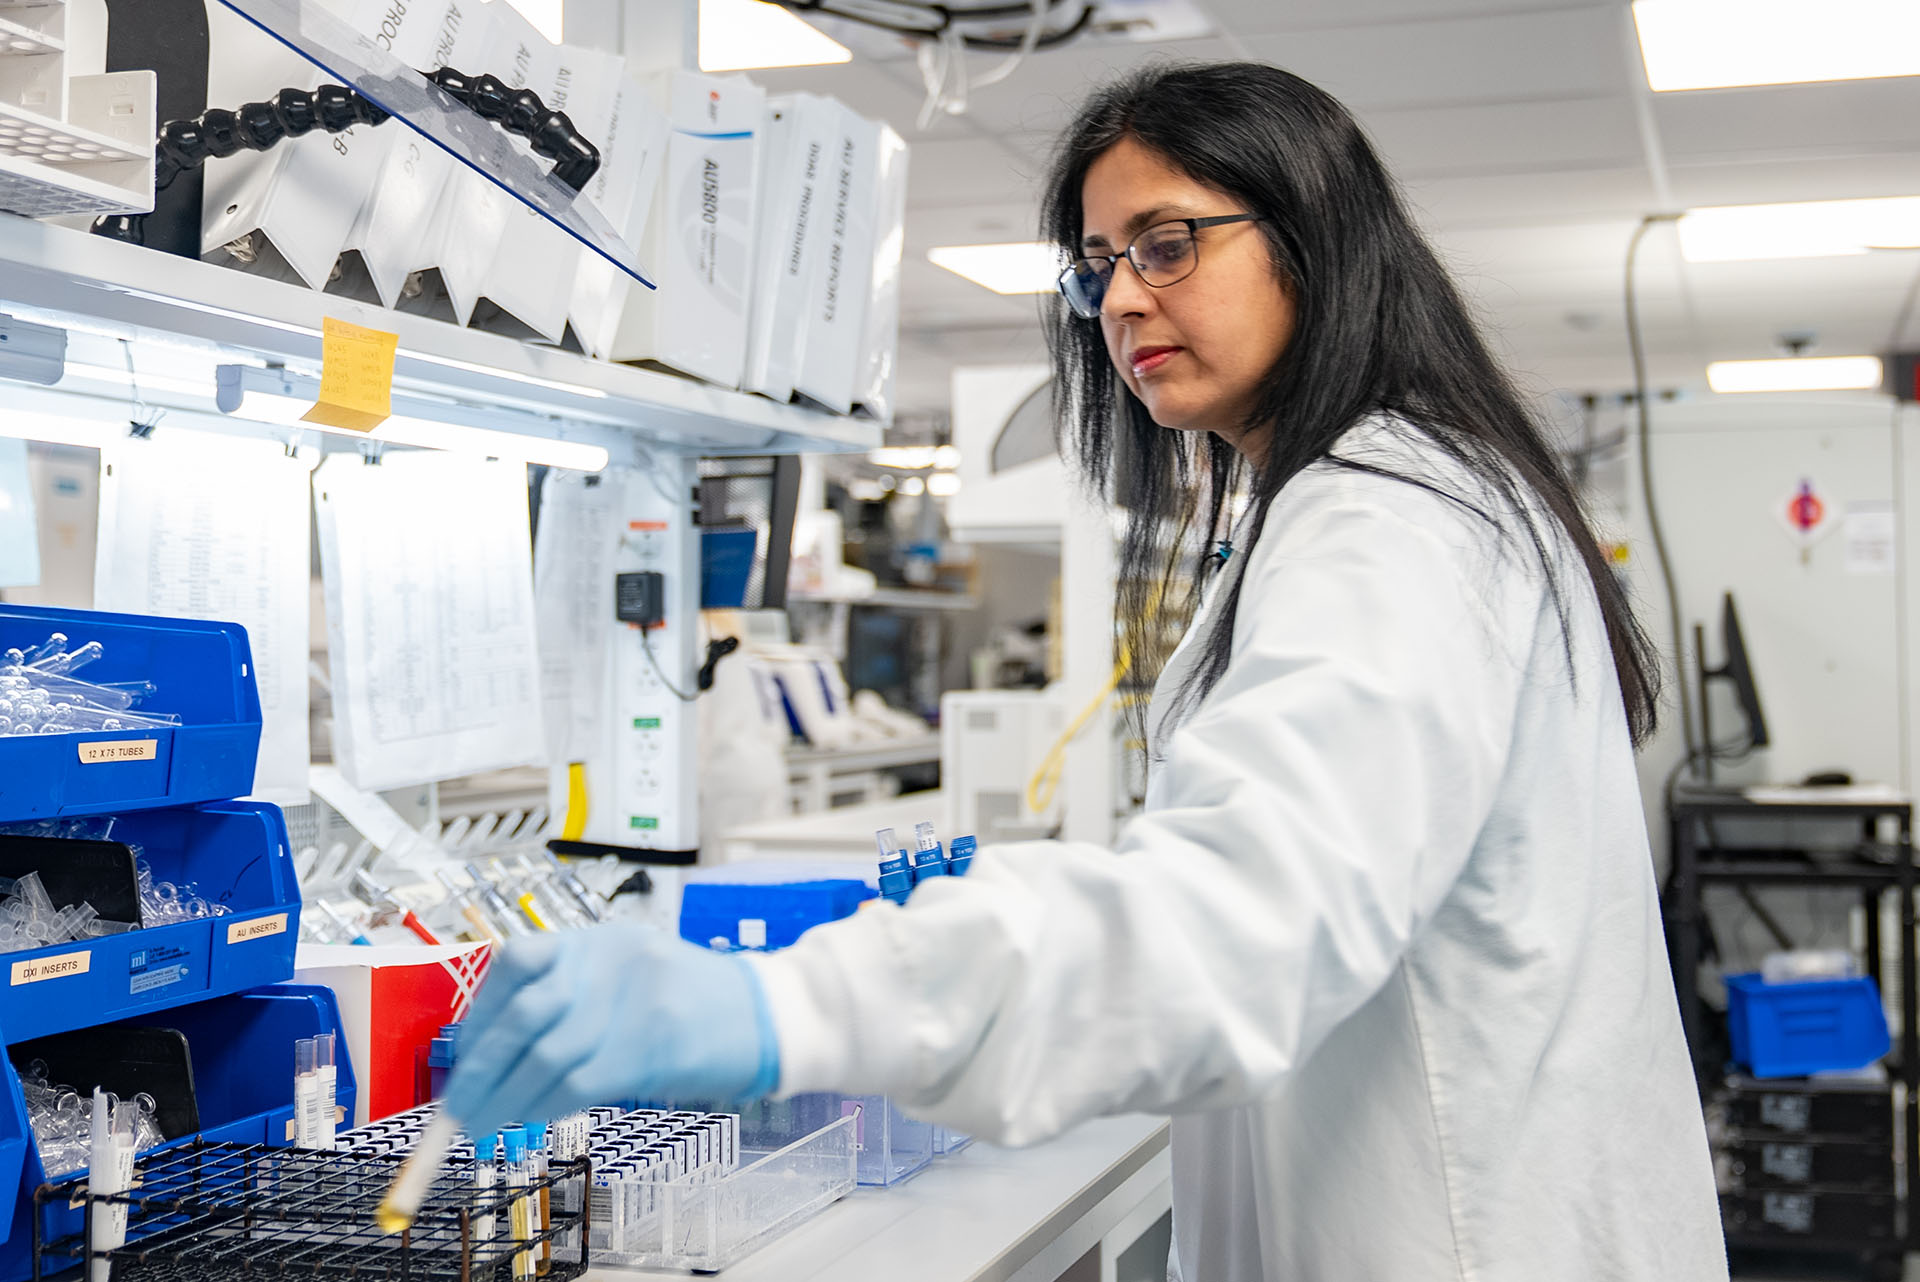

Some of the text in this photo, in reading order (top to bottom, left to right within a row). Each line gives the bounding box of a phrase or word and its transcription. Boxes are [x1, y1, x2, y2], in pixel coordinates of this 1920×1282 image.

[446, 3, 462, 33] AU
[702, 158, 720, 224] AU5800
[789, 185, 813, 276] PROCEDURES
[824, 137, 853, 322] AU SERVICE REPORTS
[88, 749, 97, 759] 12
[119, 747, 144, 757] TUBES
[236, 921, 278, 937] AU INSERTS
[23, 960, 78, 978] DXI INSERTS
